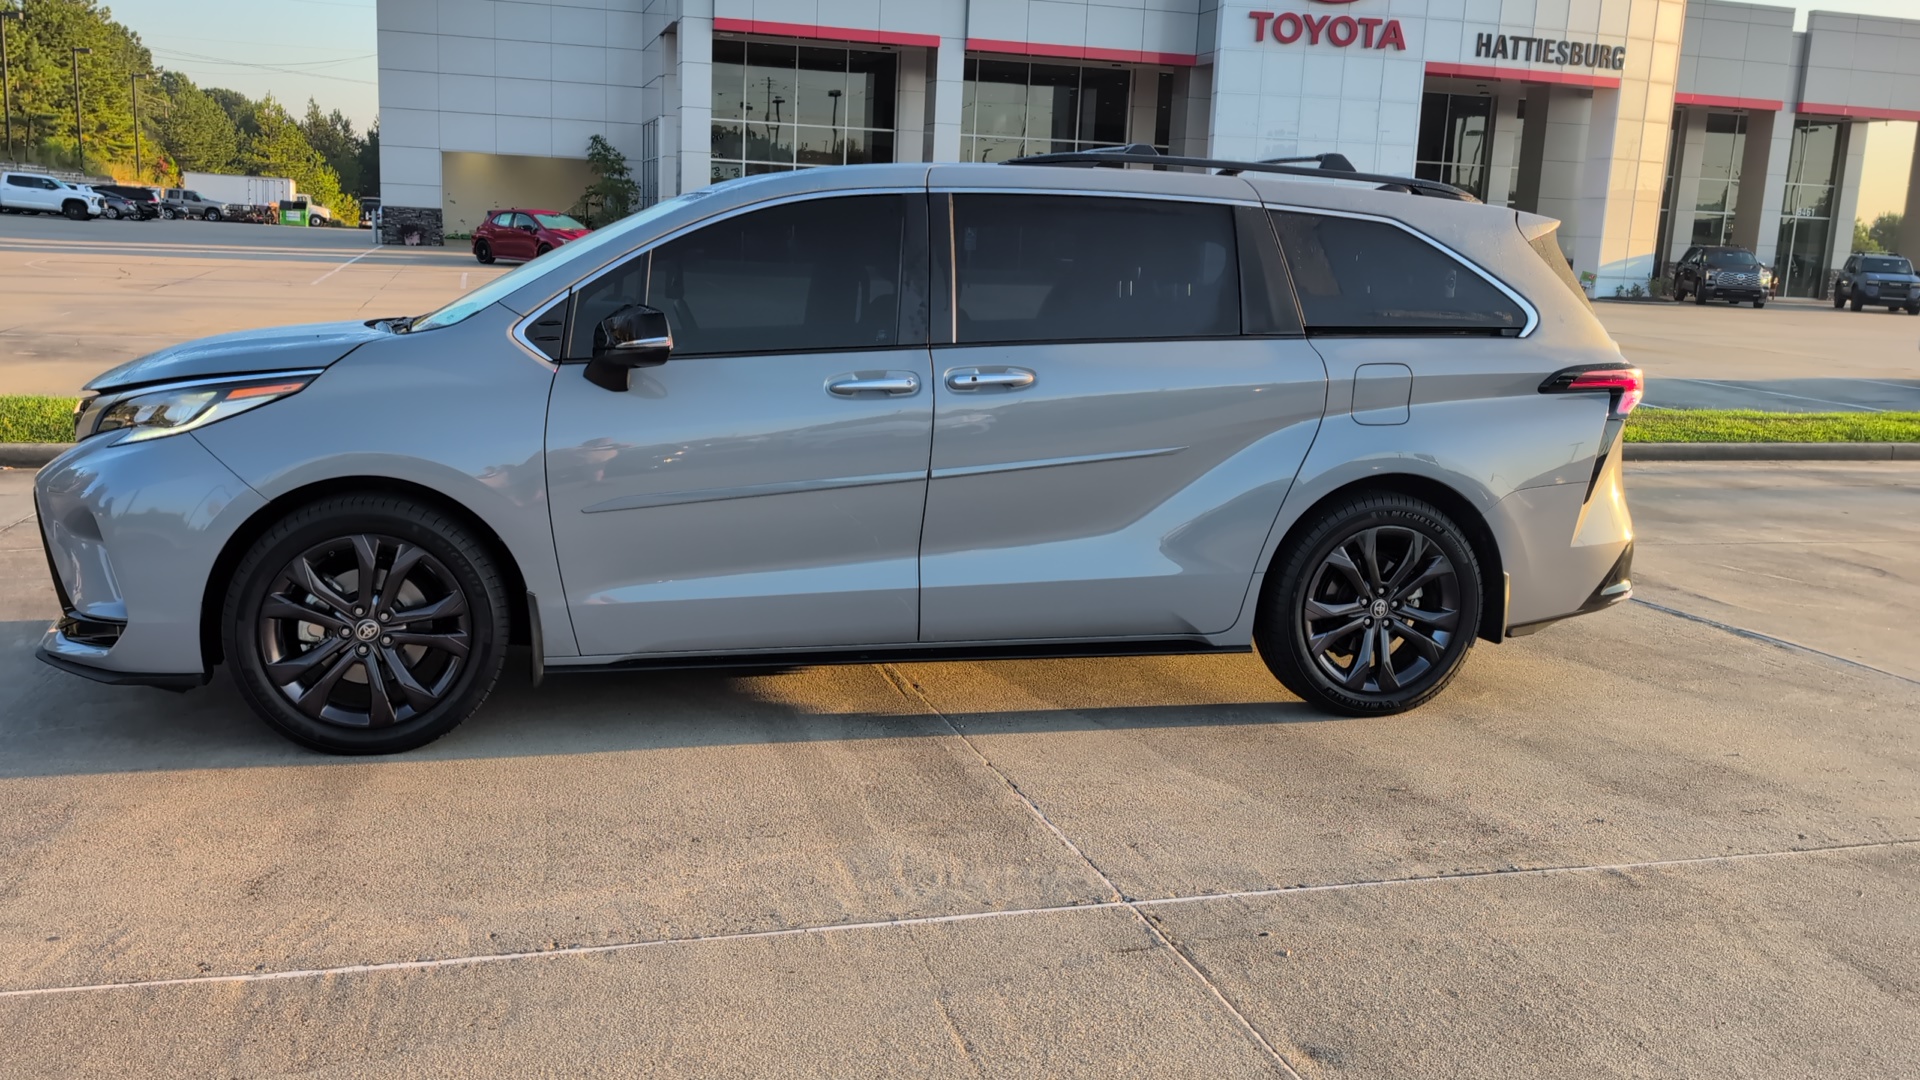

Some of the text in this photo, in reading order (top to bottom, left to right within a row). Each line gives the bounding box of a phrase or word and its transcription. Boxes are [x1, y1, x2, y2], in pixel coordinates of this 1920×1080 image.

[1249, 11, 1406, 51] TOYOTA
[1475, 32, 1626, 70] HATTIESBURG
[1391, 510, 1444, 534] MICHELIN
